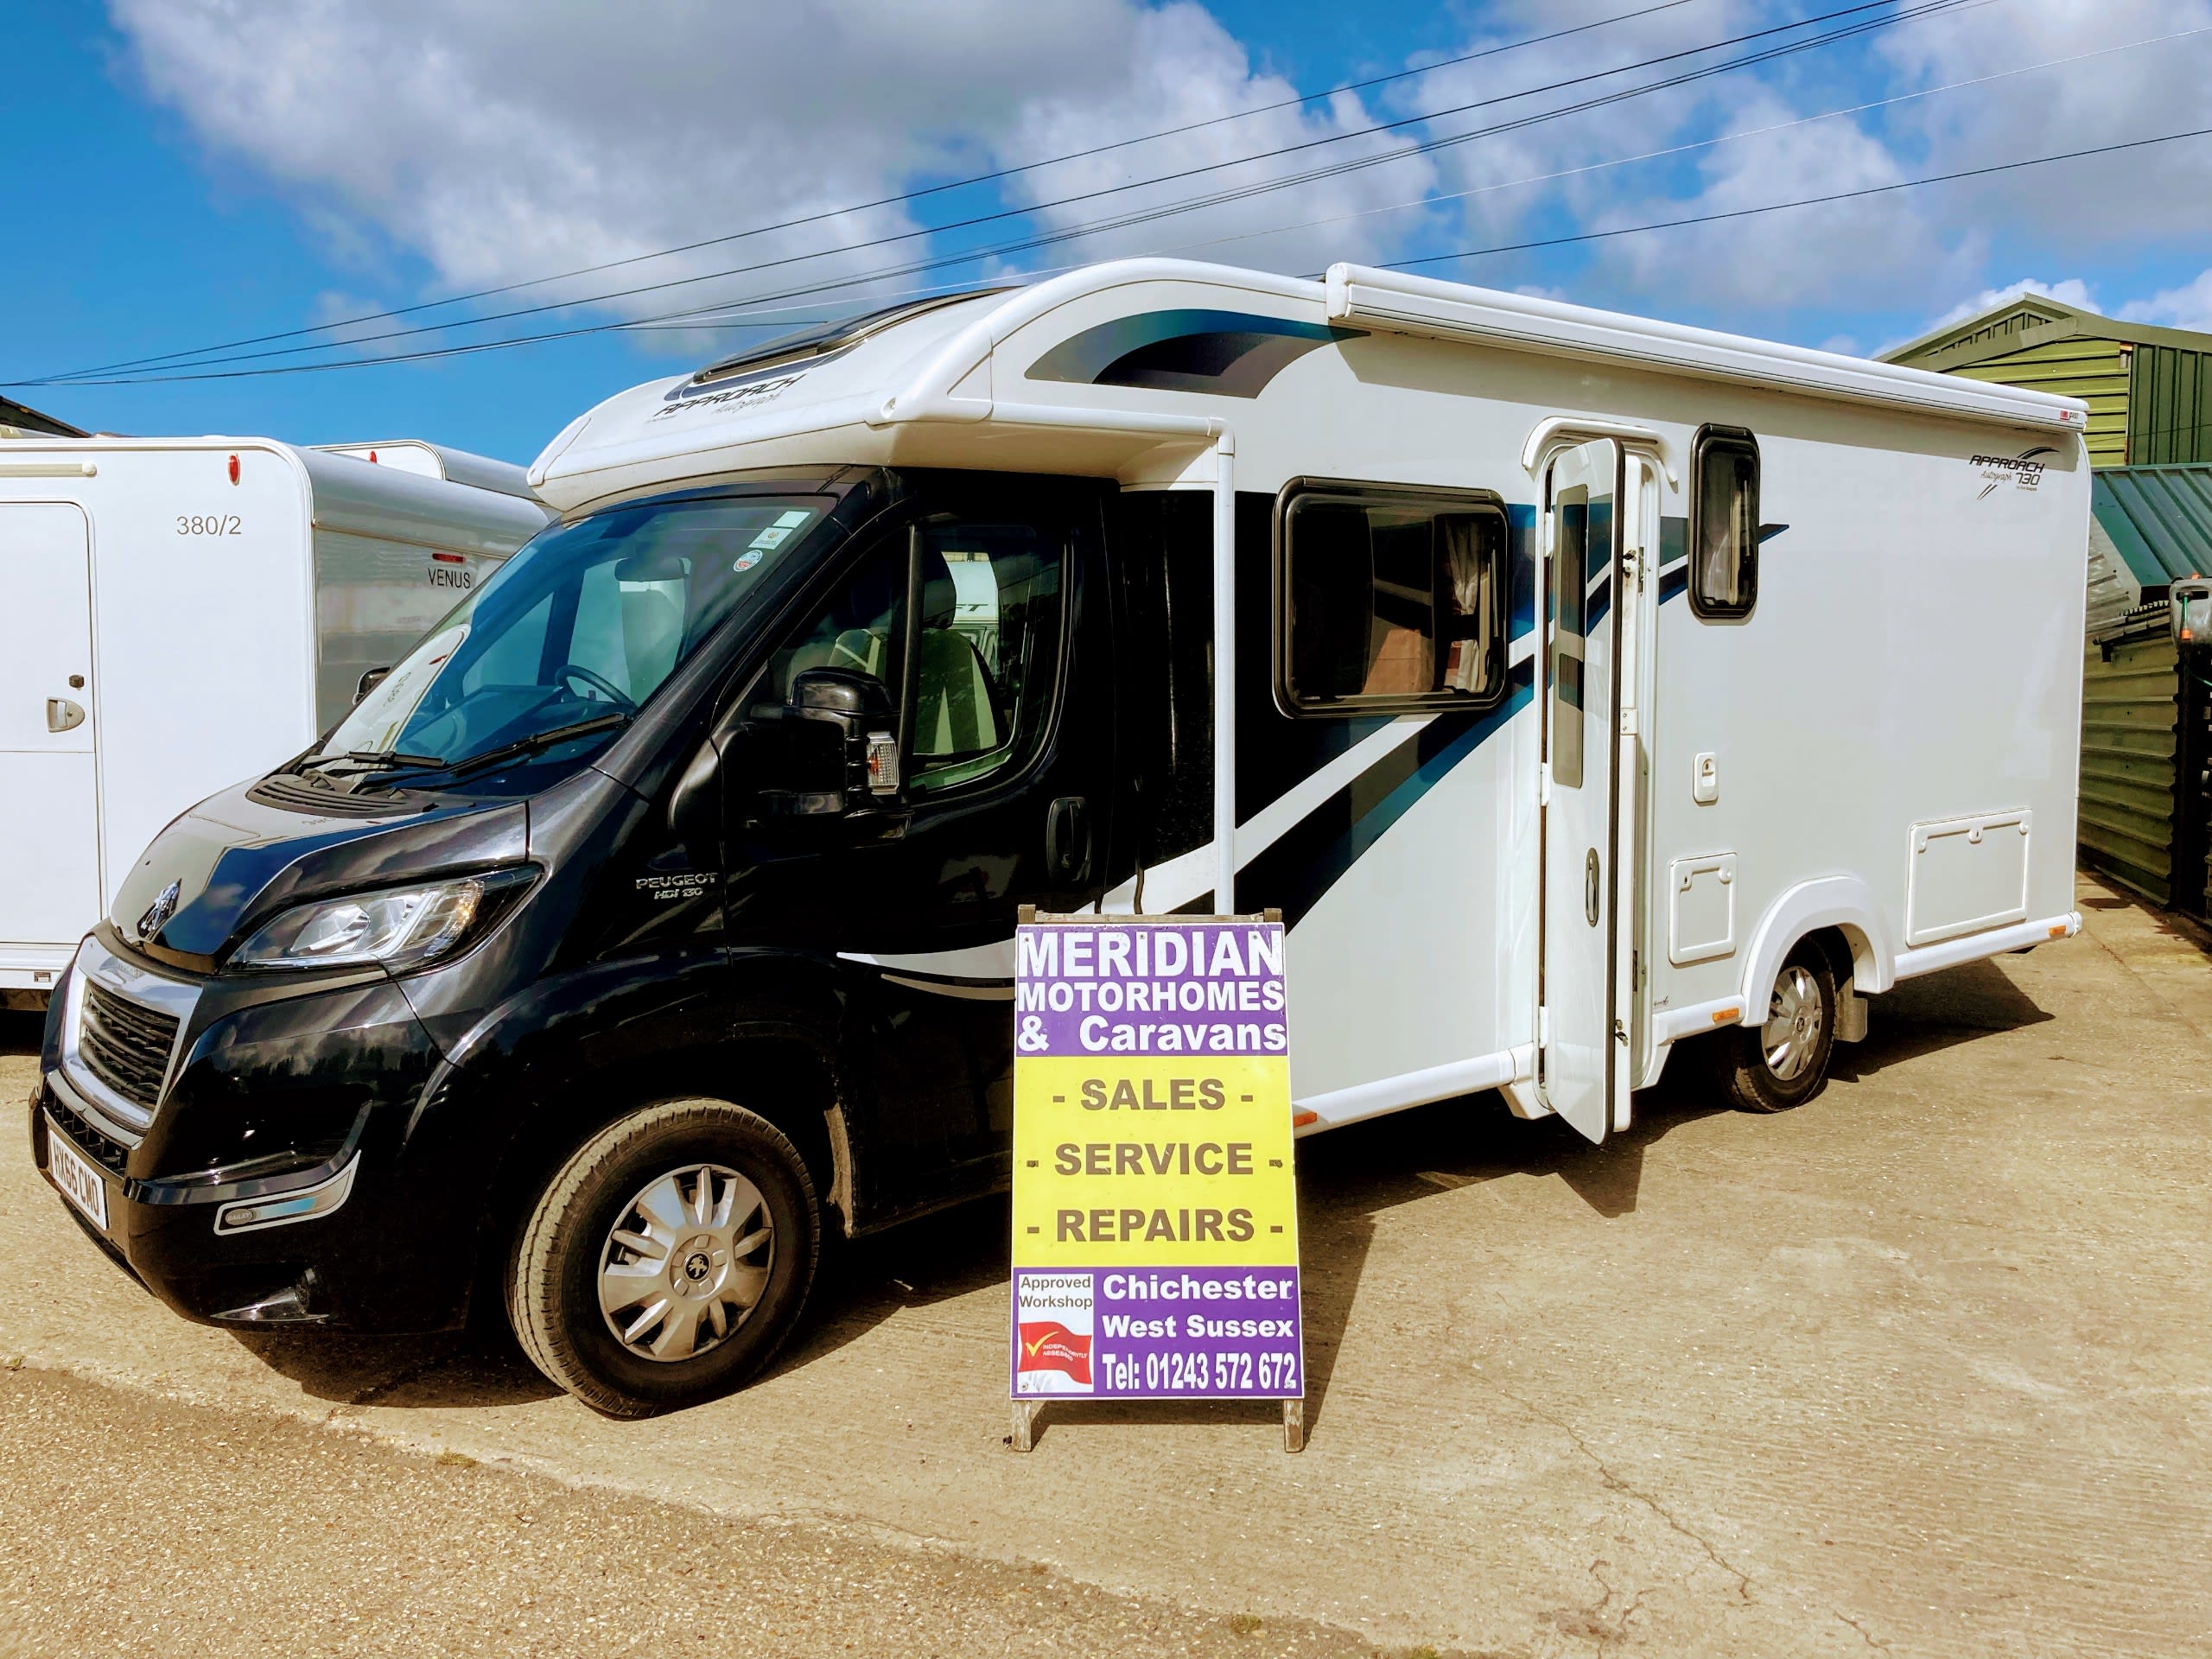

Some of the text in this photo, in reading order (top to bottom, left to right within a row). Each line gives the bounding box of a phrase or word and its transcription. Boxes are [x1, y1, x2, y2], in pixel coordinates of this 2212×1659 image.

[653, 373, 807, 416] APPROACH
[1969, 454, 2045, 473] APPROACH
[1980, 469, 2041, 486] Autograph 730
[176, 514, 242, 537] 380/2
[428, 567, 471, 589] VENUS
[635, 872, 718, 890] PEUGEOT
[1017, 931, 1284, 977] MERIDIAN
[1017, 981, 1286, 1012] MOTORHOMES
[1017, 1014, 1287, 1052] & Caravans
[1080, 1078, 1226, 1110] SALES
[1054, 1142, 1254, 1176] SERVICE
[53, 1140, 100, 1218] HX66 CMO
[1056, 1208, 1255, 1243] REPAIRS
[1021, 1275, 1091, 1292] Approved
[1102, 1274, 1294, 1300] Chichester
[1019, 1294, 1093, 1311] Workshop
[1102, 1313, 1294, 1338] West Sussex
[1102, 1352, 1297, 1390] Tel: 01243 572 672
